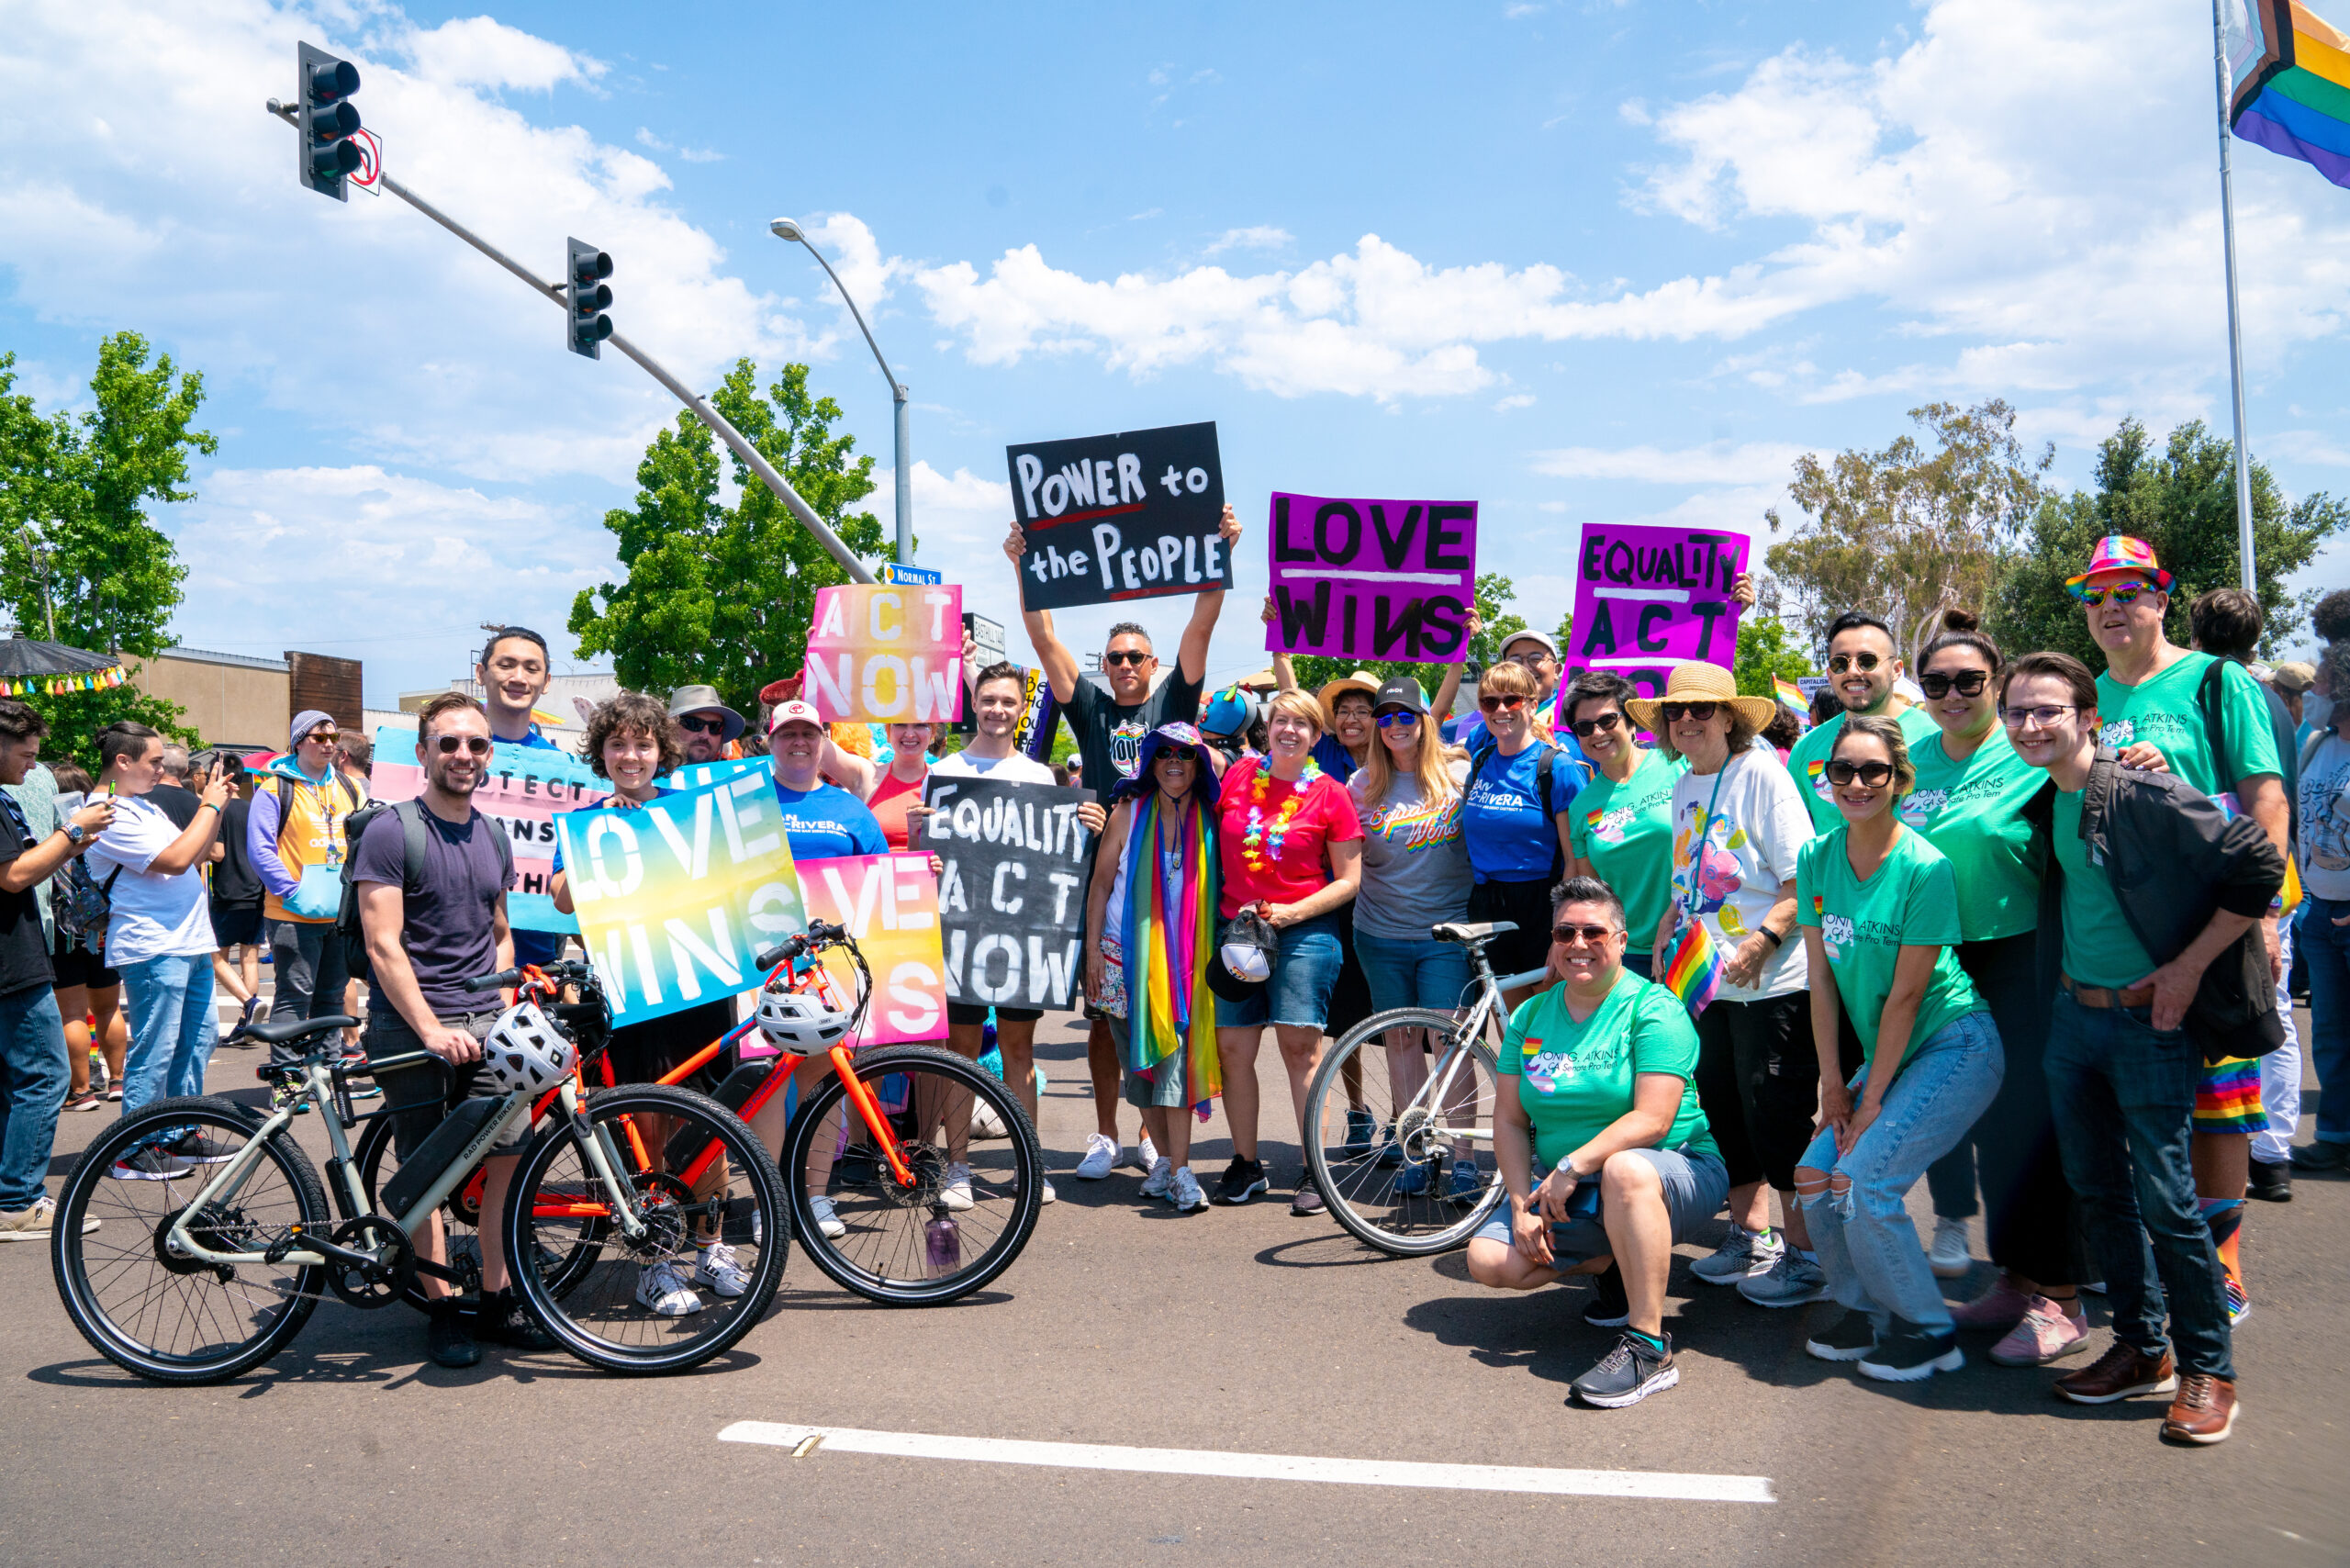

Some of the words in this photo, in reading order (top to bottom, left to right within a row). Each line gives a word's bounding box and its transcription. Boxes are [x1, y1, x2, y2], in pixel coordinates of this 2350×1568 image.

[1016, 453, 1147, 518] POWER
[1160, 465, 1209, 497] to
[1030, 545, 1090, 583] the
[1091, 522, 1225, 590] PEOPLE
[1275, 497, 1473, 570] LOVE
[897, 568, 925, 586] NORMAL
[1583, 534, 1741, 594] EQUALITY
[817, 592, 952, 642] ACT
[1274, 581, 1466, 658] WINS
[1581, 599, 1728, 659] ACT
[803, 652, 961, 722] NOW
[2143, 712, 2188, 725] ATKINS
[2149, 723, 2165, 733] Pro
[1603, 807, 1625, 822] TONI
[1914, 787, 1941, 799] TONI
[1942, 786, 1955, 796] G.
[1959, 778, 2004, 794] ATKINS
[1922, 798, 1934, 806] CA
[1966, 792, 1981, 801] Pro
[1983, 790, 2001, 798] Tem
[556, 770, 781, 902] LOVE
[1405, 814, 1459, 846] Wins
[938, 859, 1080, 924] ACT
[583, 881, 802, 1015] WINS
[1822, 911, 1850, 927] TONI
[1859, 920, 1901, 936] ATKINS
[1831, 927, 1844, 937] CA
[1864, 934, 1880, 945] Pro
[1882, 935, 1899, 946] Tem
[944, 928, 1082, 1006] NOW
[1539, 1049, 1564, 1061] TONI
[1567, 1051, 1580, 1062] G.
[1548, 1061, 1561, 1070] CA
[1562, 1063, 1587, 1072] Senate
[1587, 1062, 1602, 1070] Pro
[738, 1103, 753, 1117] RAD
[753, 1081, 772, 1104] POWER
[771, 1062, 789, 1082] BIKES
[463, 1144, 477, 1160] RAD
[476, 1119, 499, 1147] POWER
[497, 1099, 516, 1122] BIKES
